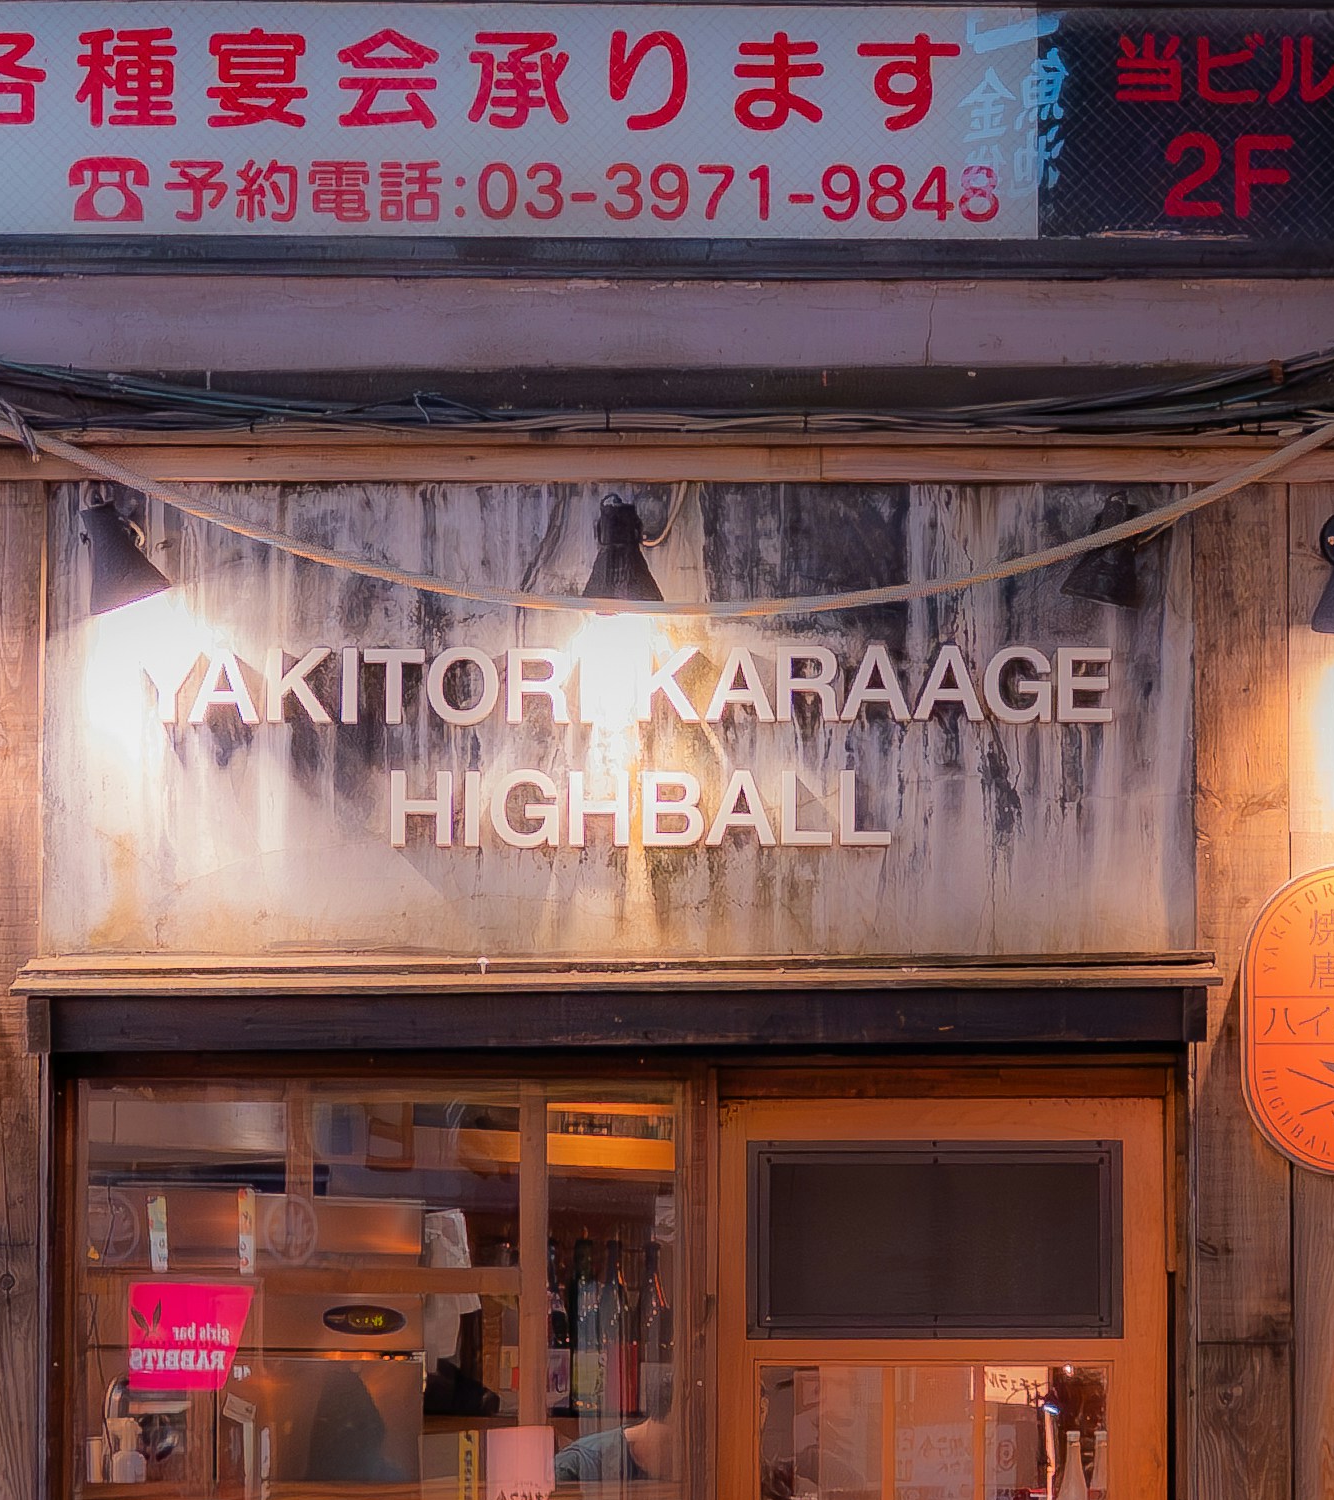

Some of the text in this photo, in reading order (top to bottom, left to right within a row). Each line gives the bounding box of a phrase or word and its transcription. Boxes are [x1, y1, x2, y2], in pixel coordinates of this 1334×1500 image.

[1164, 131, 1296, 219] 2F
[635, 644, 1115, 725] KARAAGE
[389, 768, 892, 850] HIGHBALL
